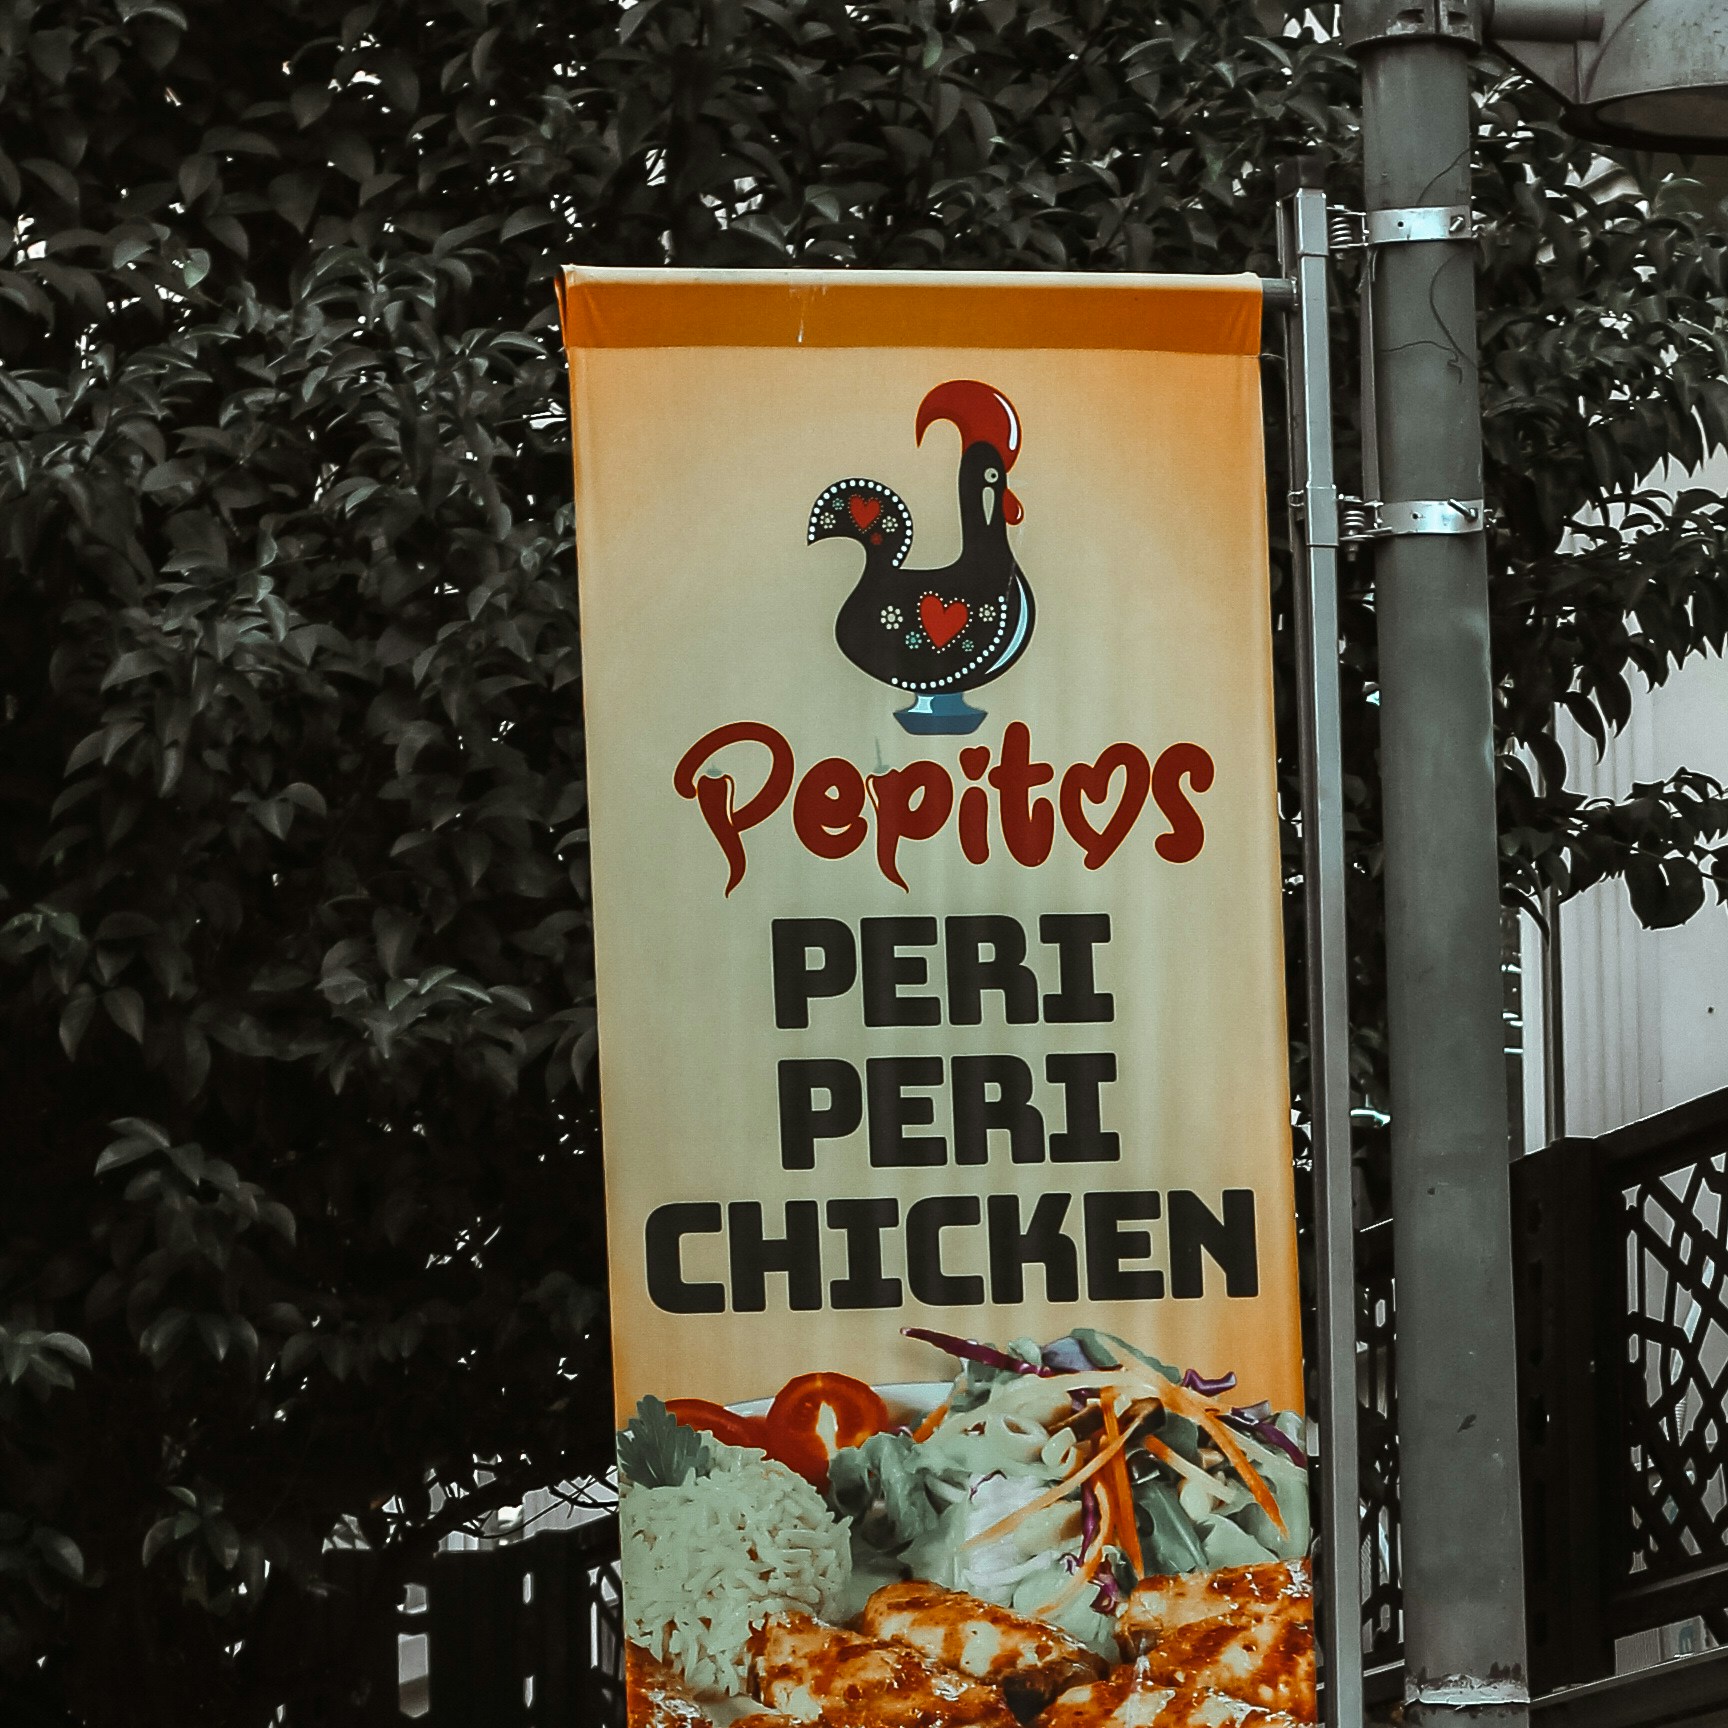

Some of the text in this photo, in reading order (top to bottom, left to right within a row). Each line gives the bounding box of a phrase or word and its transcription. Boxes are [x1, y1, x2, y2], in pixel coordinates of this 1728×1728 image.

[673, 720, 1215, 899] Pepitos
[771, 913, 1115, 1029] PERI
[777, 1052, 1121, 1171] PERI
[644, 1188, 1259, 1315] CHICKEN
